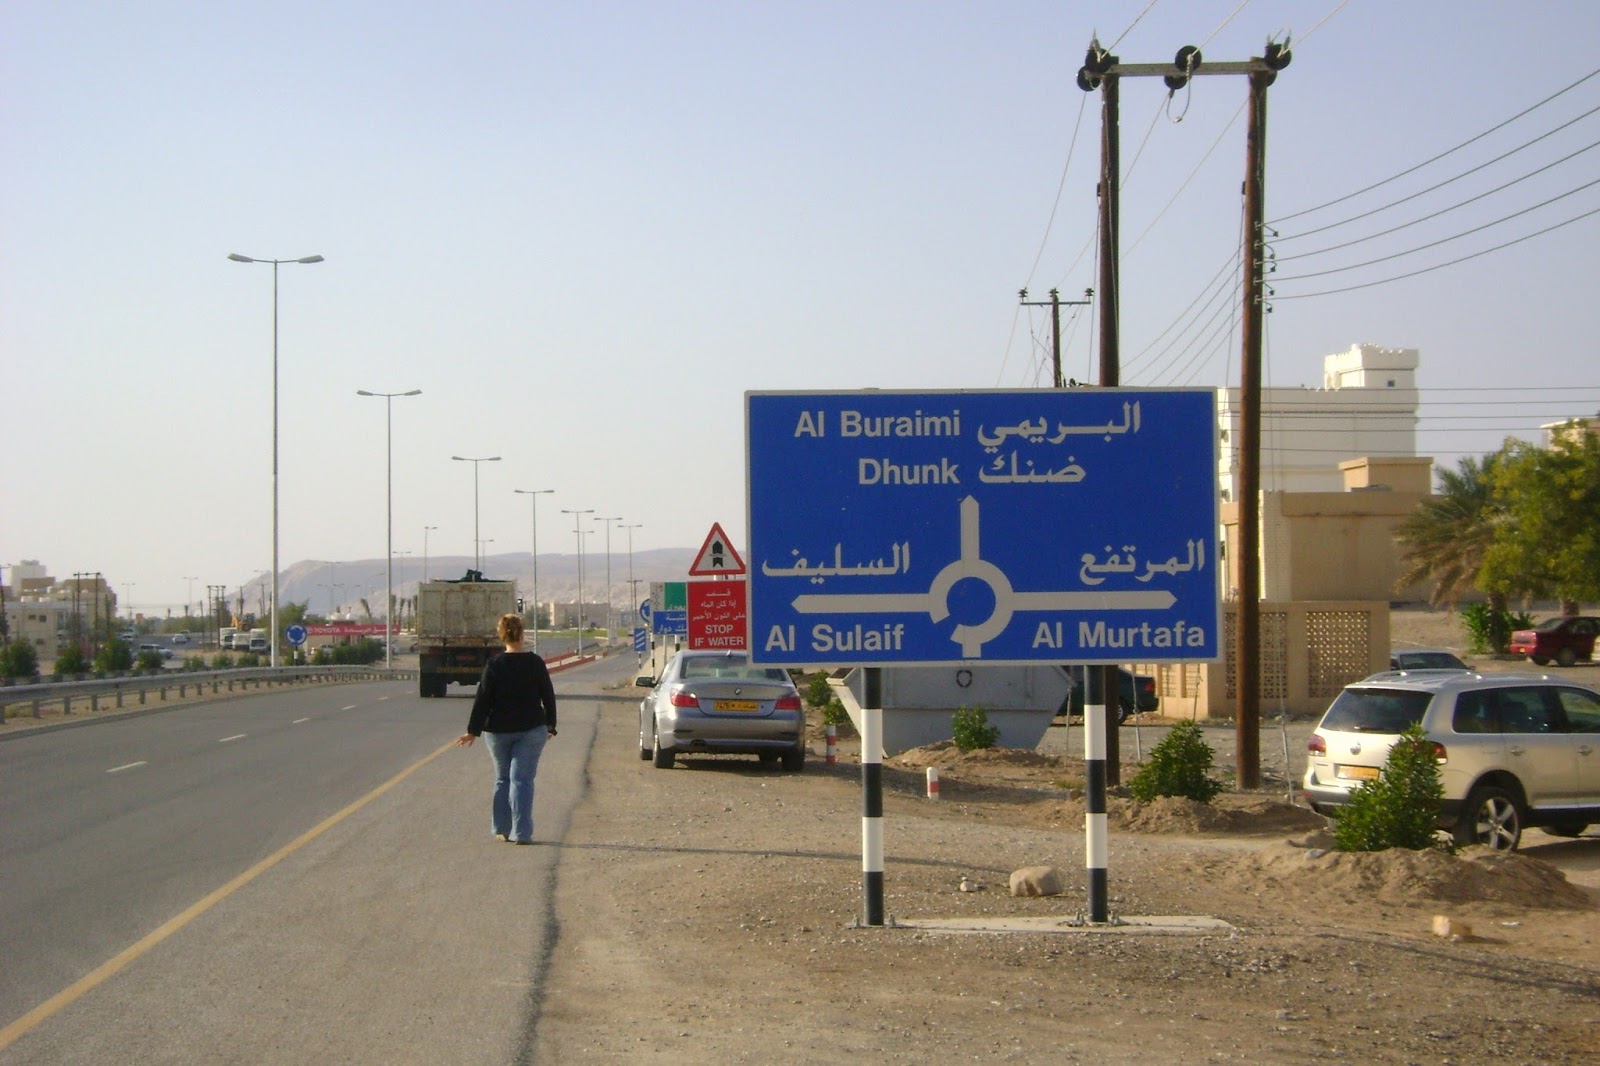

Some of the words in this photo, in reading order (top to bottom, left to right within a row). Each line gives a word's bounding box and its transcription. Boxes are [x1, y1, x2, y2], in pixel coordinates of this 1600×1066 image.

[795, 411, 824, 437] Al
[841, 410, 960, 437] Buraimi
[977, 401, 1140, 454] البريمي
[859, 458, 960, 485] Dhunk
[979, 450, 1087, 484] ضنك
[762, 541, 910, 584] السليف
[1080, 539, 1205, 585] المرتفع
[694, 637, 704, 647] IF
[709, 636, 744, 646] WATER
[705, 624, 733, 634] STOP
[765, 626, 795, 652] Al
[811, 624, 904, 652] Sulaif
[1032, 622, 1060, 648] Al
[1079, 620, 1205, 648] Murtafa
